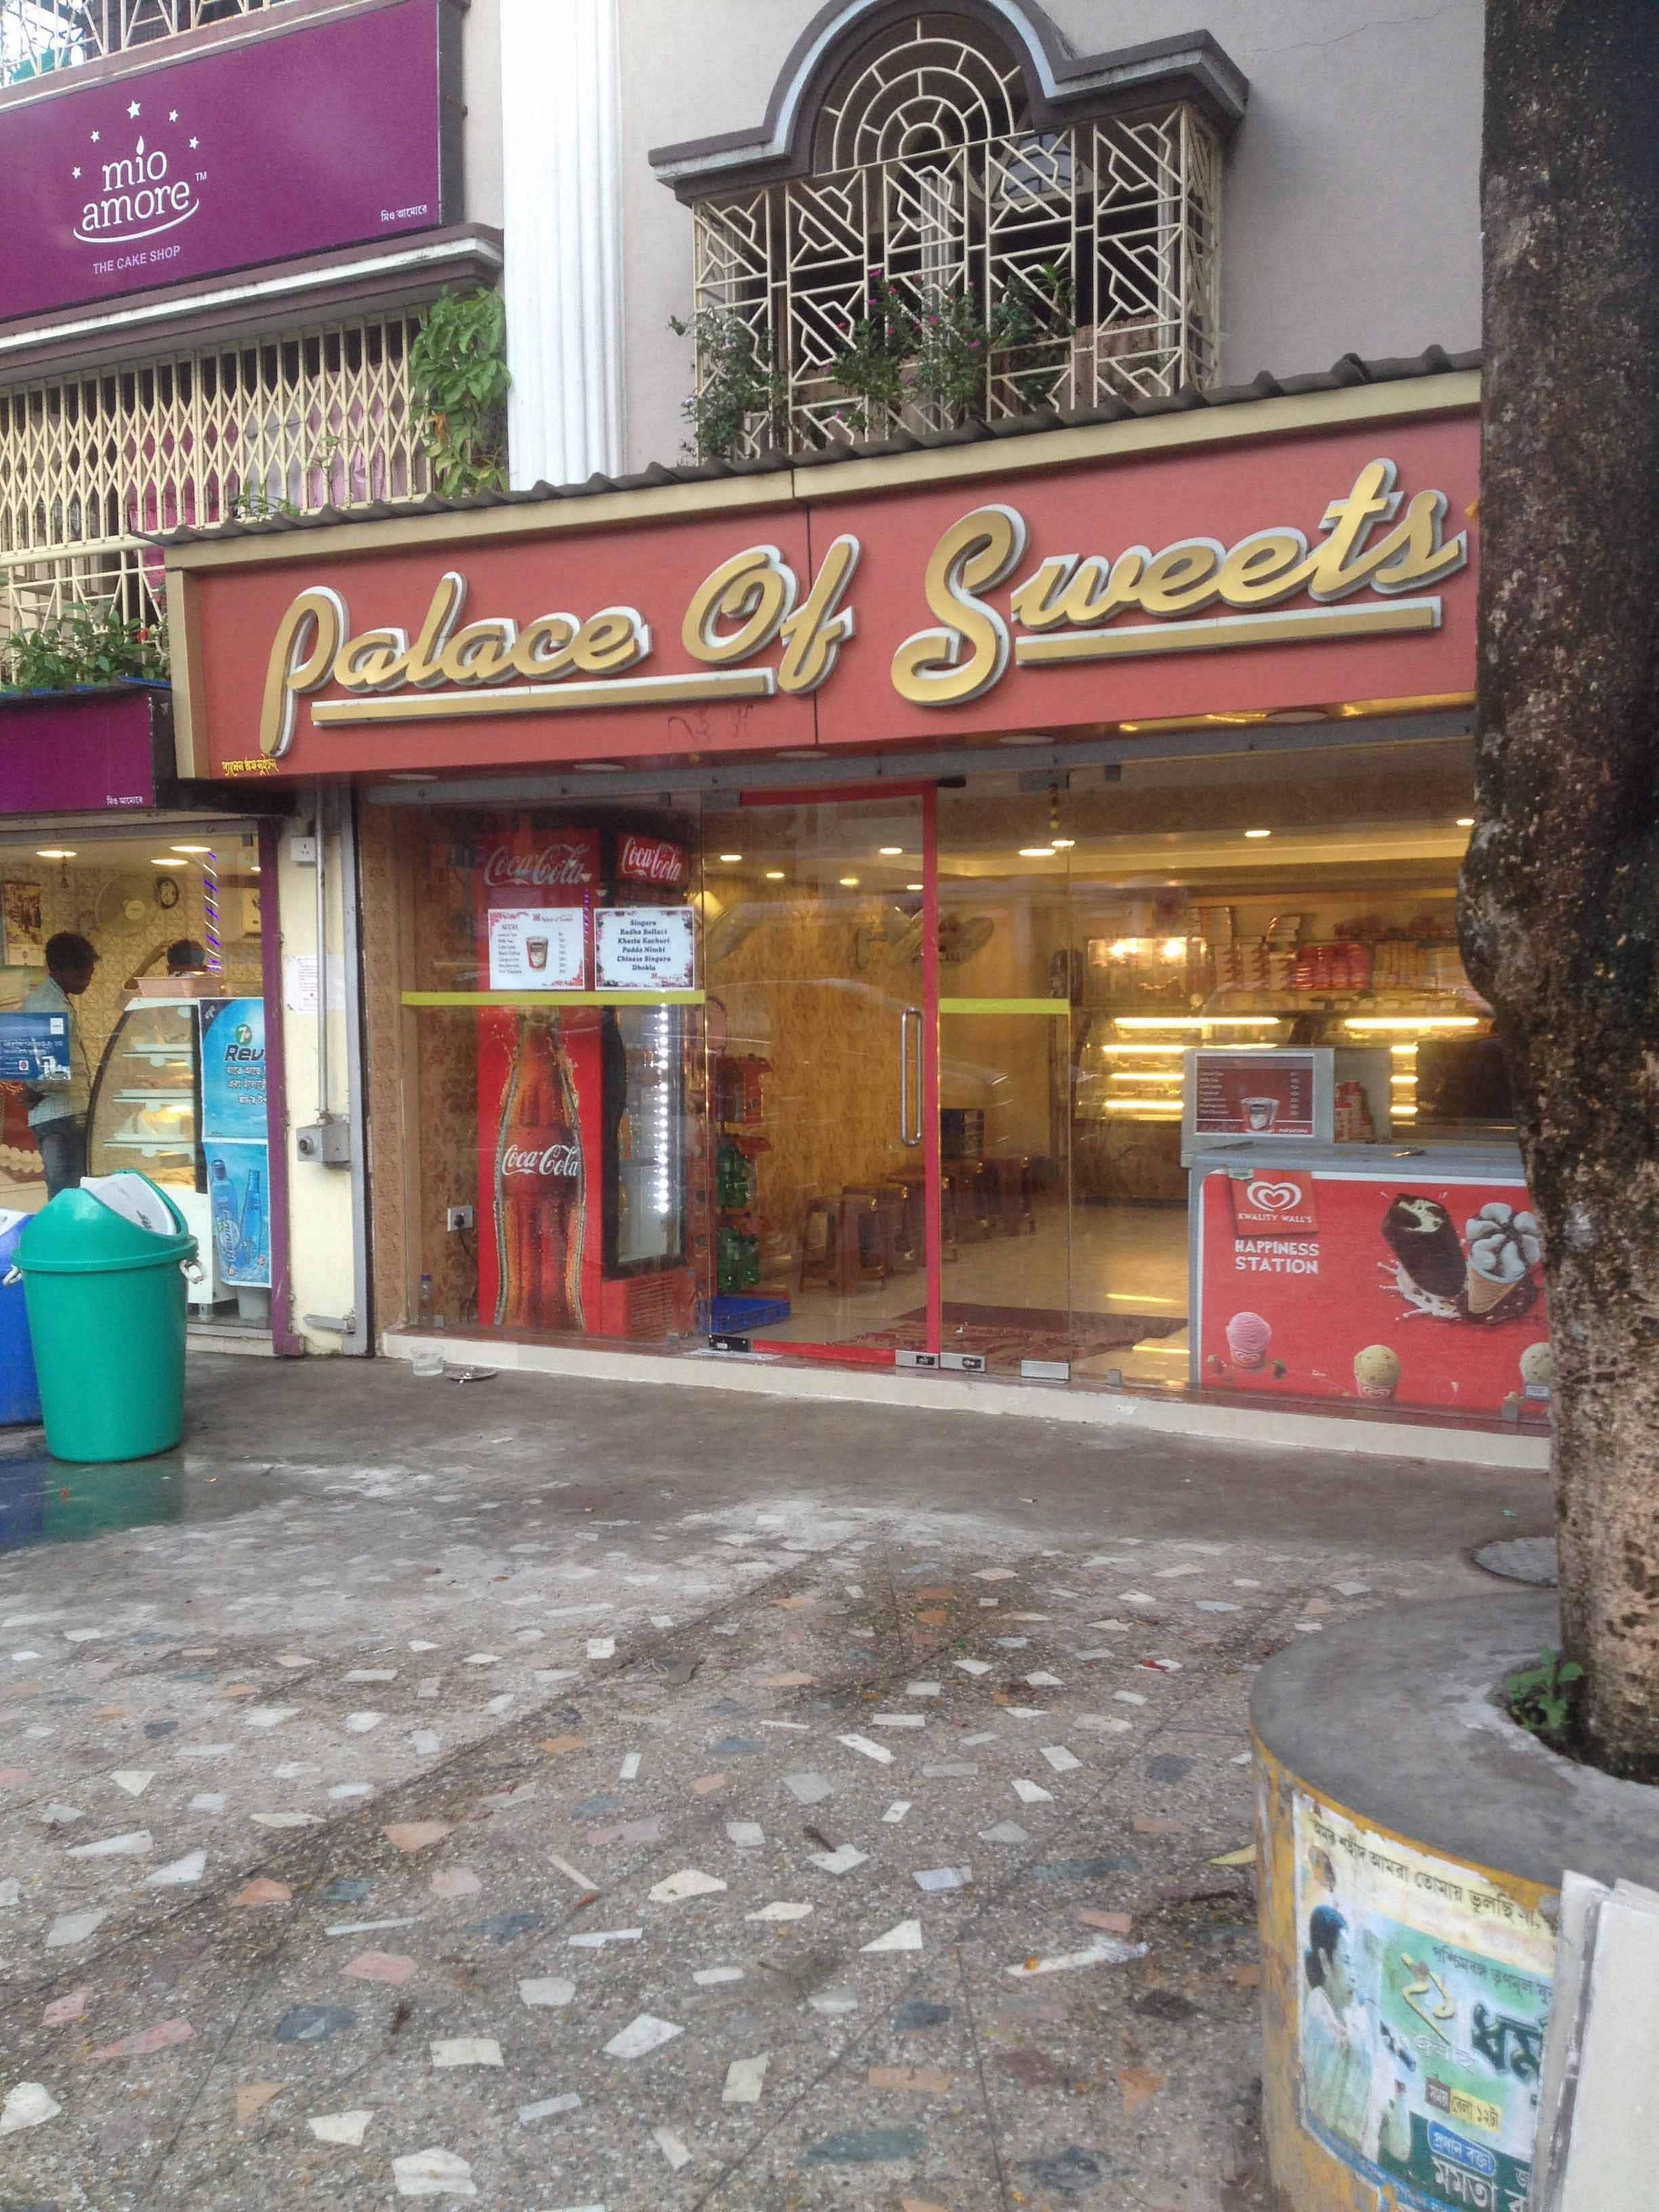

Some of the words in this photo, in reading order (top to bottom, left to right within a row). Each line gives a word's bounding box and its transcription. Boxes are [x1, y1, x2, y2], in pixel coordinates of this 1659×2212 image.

[102, 150, 167, 192] mio
[82, 181, 190, 231] amore
[94, 260, 115, 274] THE
[117, 253, 146, 270] CAKE
[149, 245, 180, 262] SHOP
[260, 571, 652, 758] Palace
[681, 533, 861, 695] Of
[890, 457, 1467, 707] Sweets
[483, 843, 590, 886] Coca-Cola
[621, 836, 683, 882] Coca-Cola
[501, 1144, 581, 1176] Coca-Cola
[1237, 1212, 1278, 1221] KWALITY
[1235, 1239, 1320, 1256] HAPPINESS
[1235, 1255, 1319, 1274] STATION
